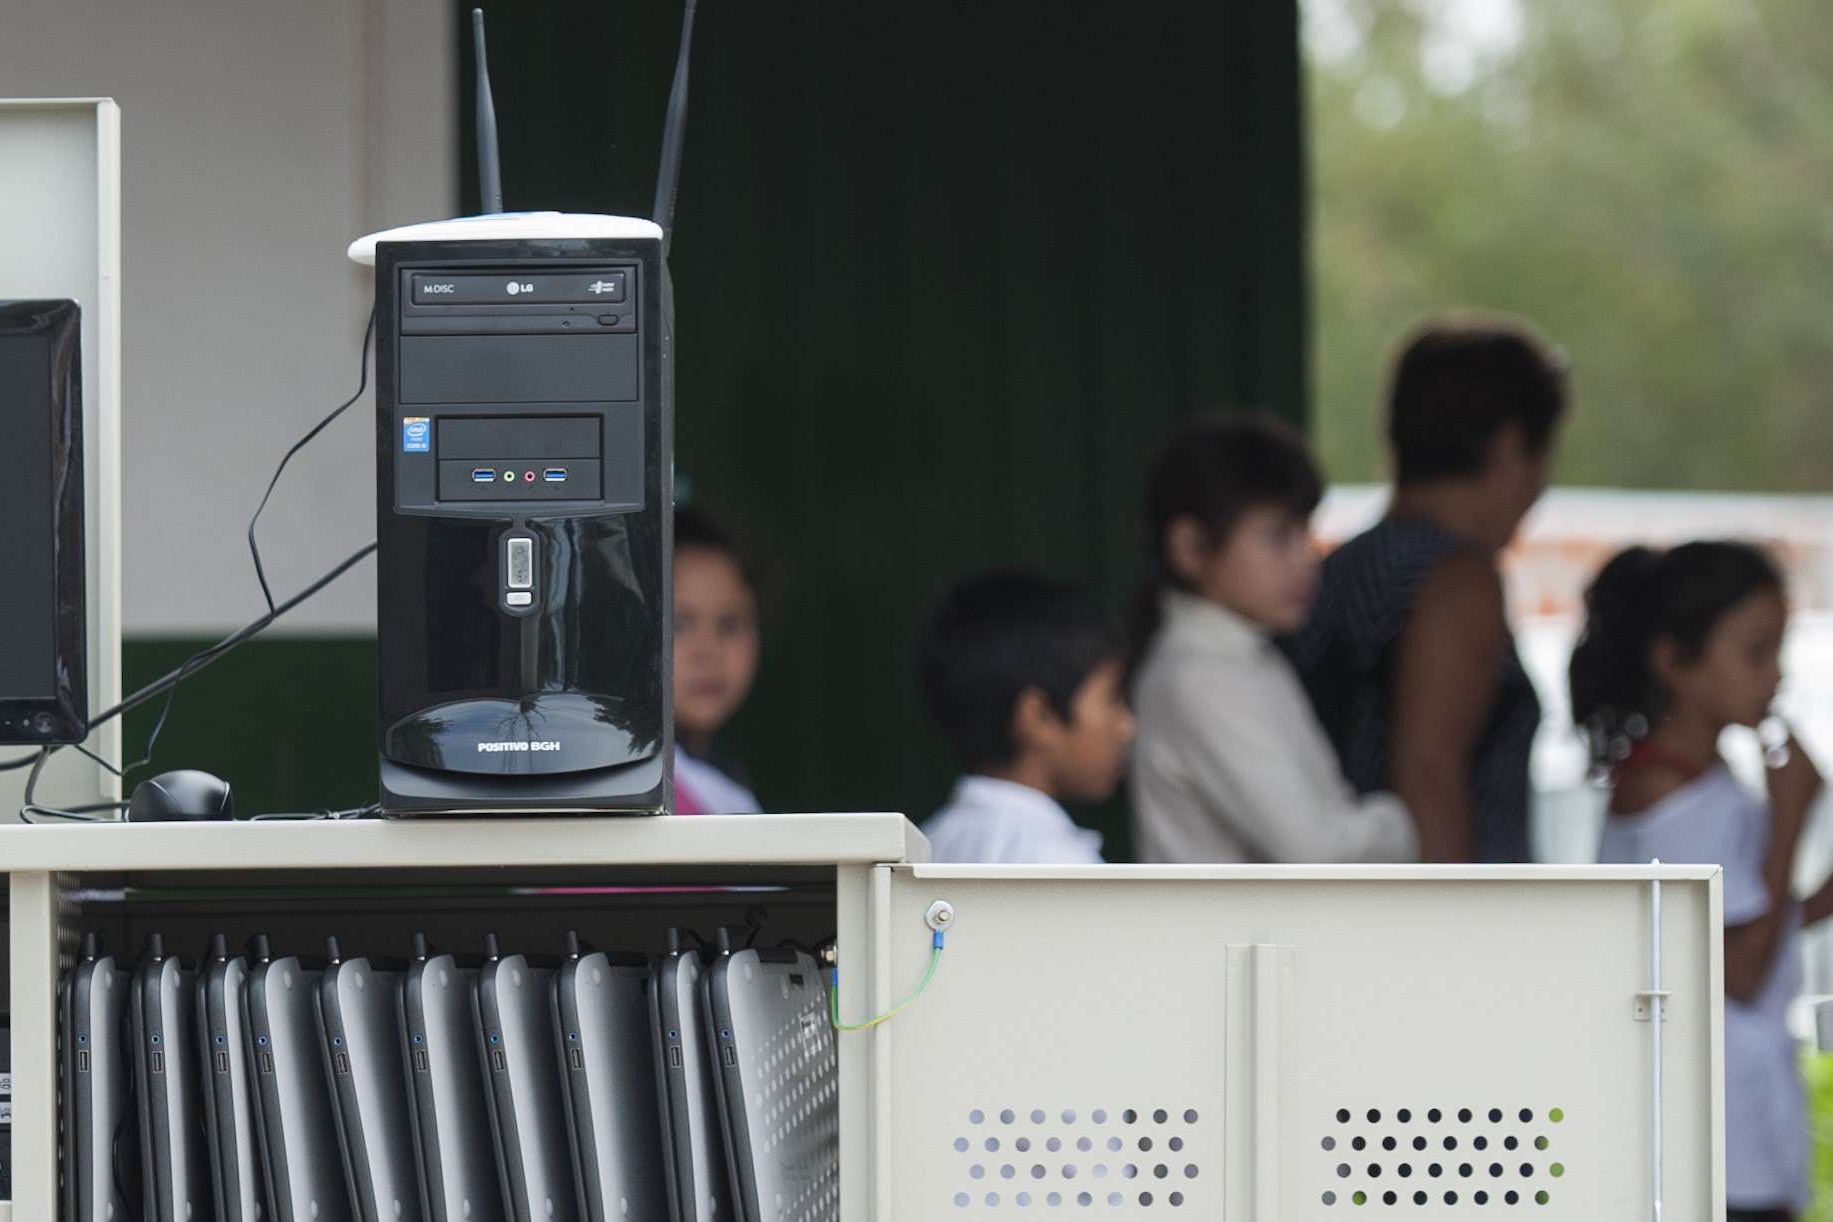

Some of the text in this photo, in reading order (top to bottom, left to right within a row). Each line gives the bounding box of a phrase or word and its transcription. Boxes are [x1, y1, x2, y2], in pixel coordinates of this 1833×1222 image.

[520, 283, 534, 293] LG
[477, 741, 560, 752] POSITIVO BGH
